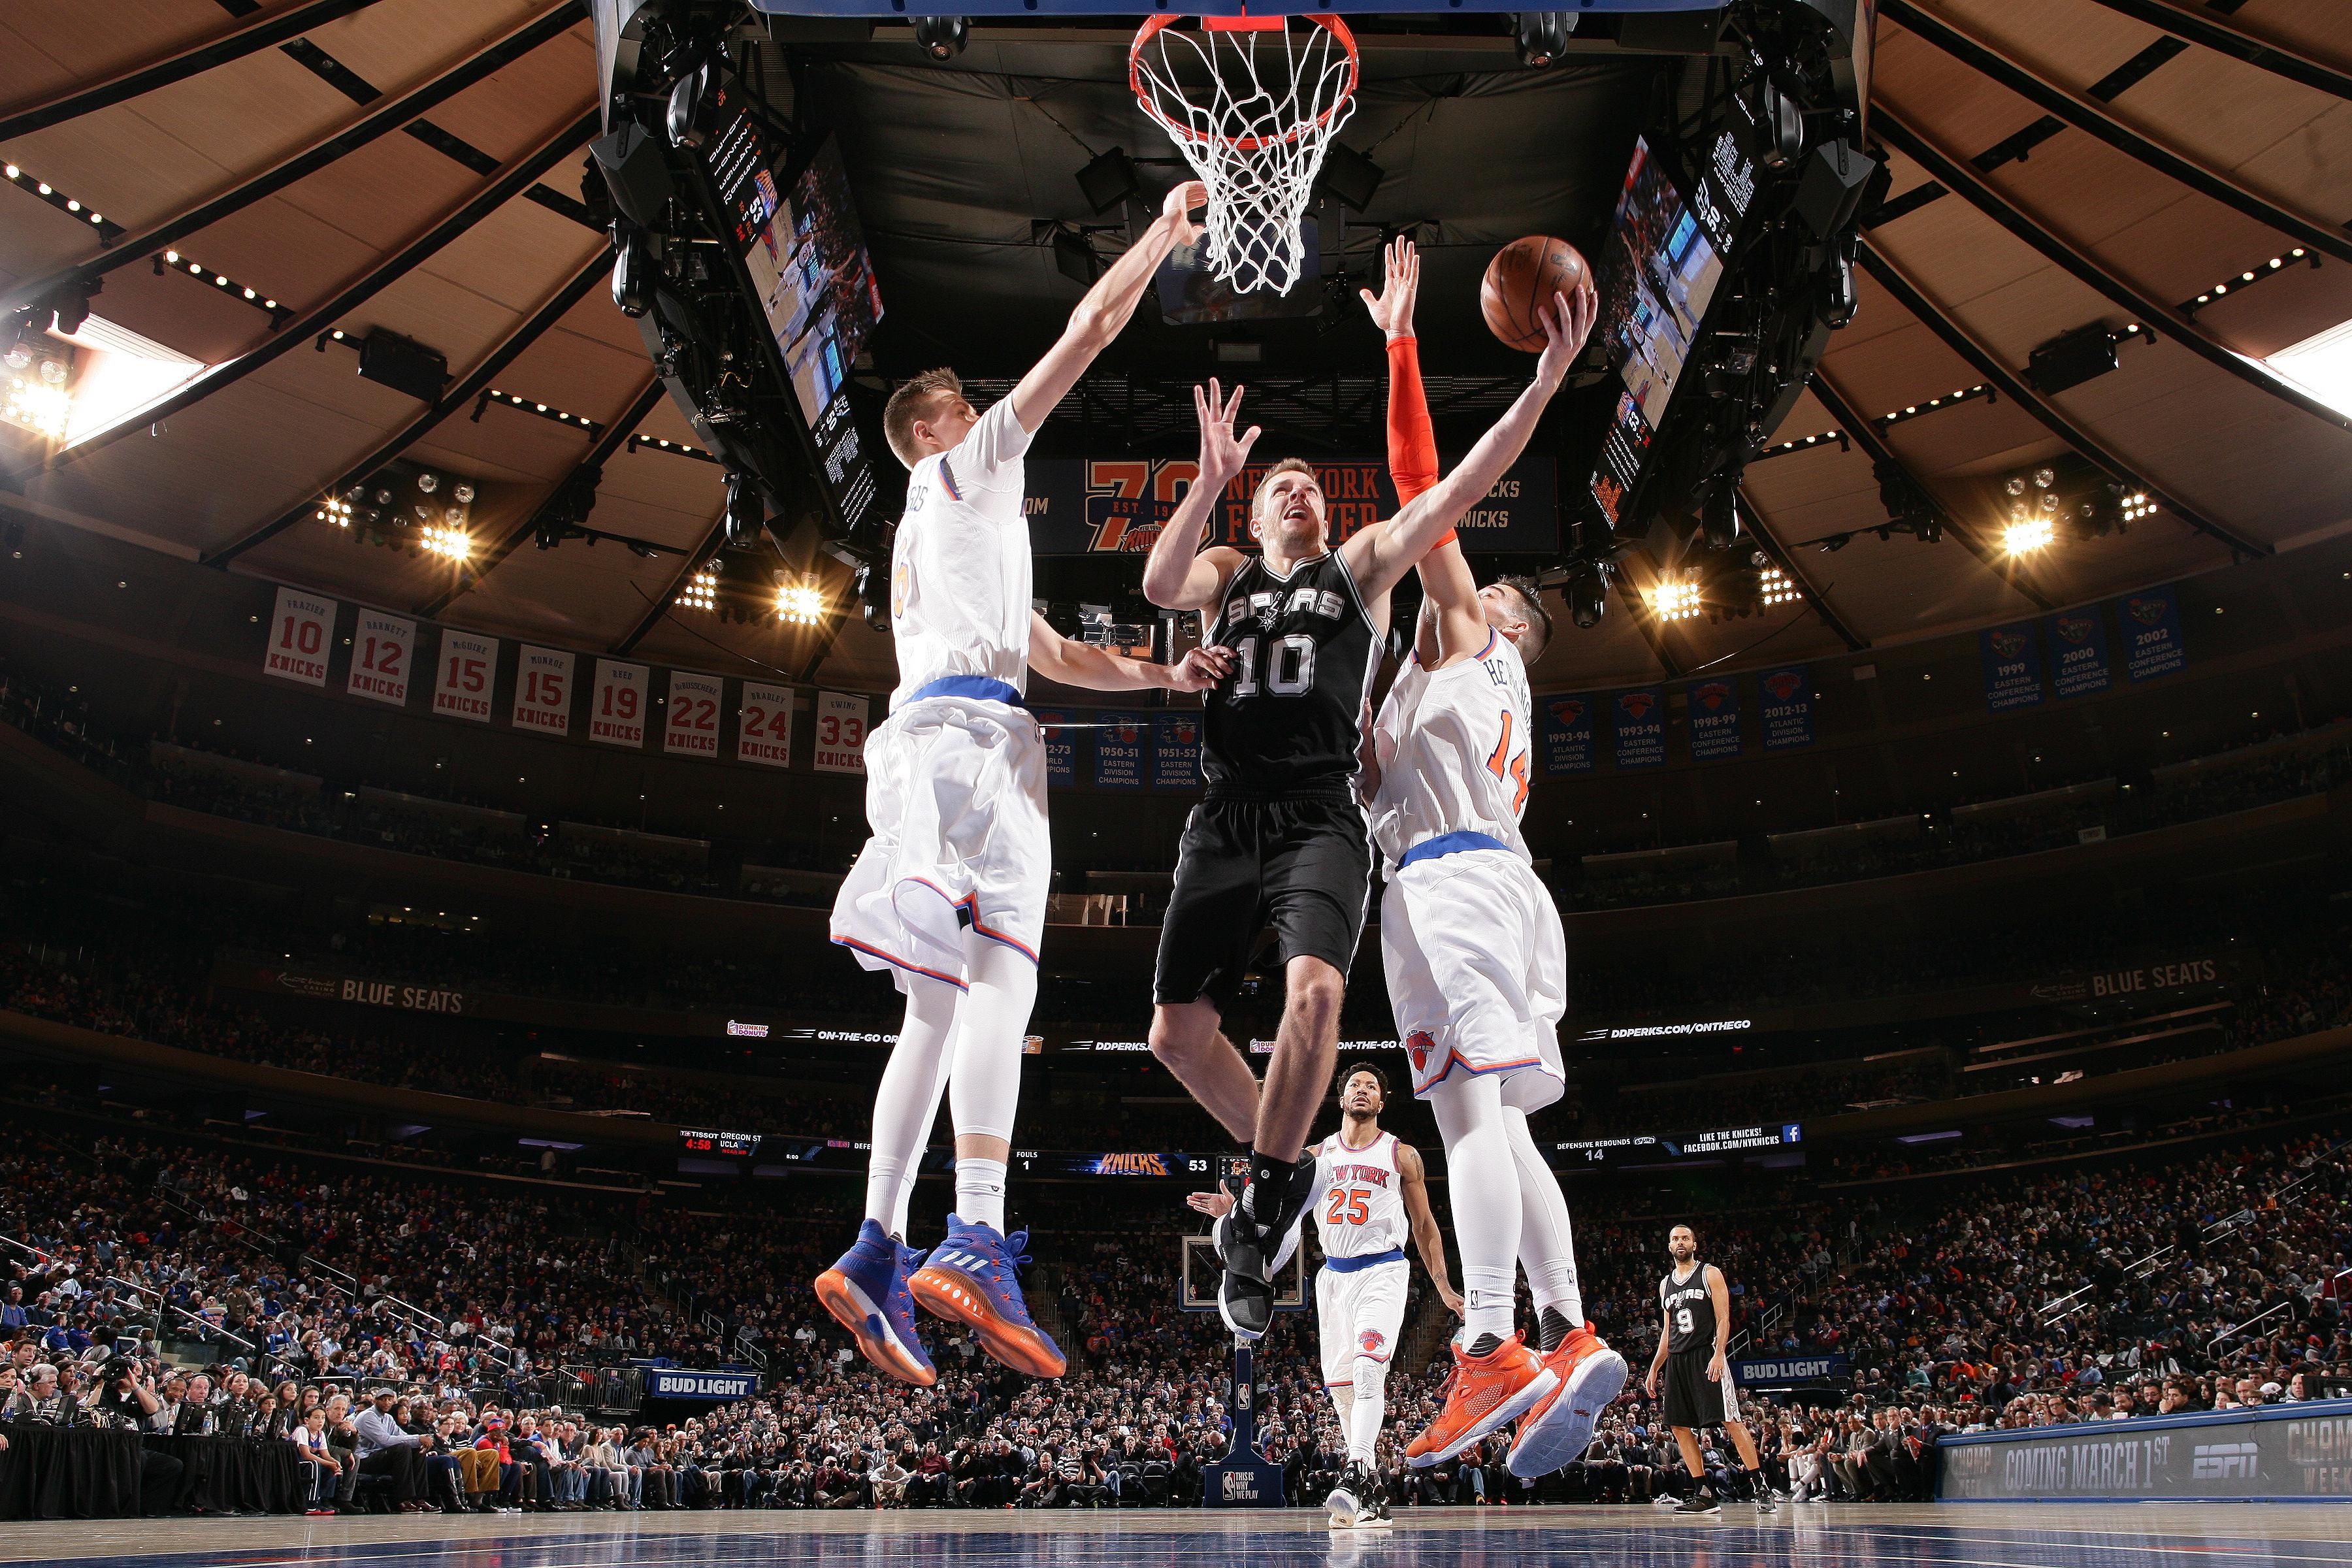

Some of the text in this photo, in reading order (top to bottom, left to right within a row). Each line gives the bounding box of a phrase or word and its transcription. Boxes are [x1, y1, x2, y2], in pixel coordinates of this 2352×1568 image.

[1716, 131, 1734, 171] LEONARD
[1723, 146, 1739, 180] PARKER
[1730, 169, 1739, 189] LEE
[1735, 157, 1754, 199] ALDRIDGE
[1741, 180, 1755, 208] GREEN
[750, 196, 765, 223] 53
[1707, 206, 1720, 232] 50
[1629, 411, 1640, 432] 53
[1315, 468, 1380, 498] ORK
[1113, 501, 1143, 515] EST.
[287, 599, 325, 616] FRAZIER
[1228, 588, 1345, 631] SPURS
[280, 616, 323, 655] 10
[366, 621, 408, 638] BARNETT
[2136, 628, 2168, 646] 2002
[362, 636, 403, 676] 12
[2135, 641, 2173, 658] EASTERN
[269, 653, 325, 679] KNICKS
[531, 655, 564, 669] MONROE
[1233, 634, 1317, 698] 10
[2129, 648, 2183, 670] CONFERENCE
[447, 656, 487, 693] 15
[612, 670, 632, 680] REED
[1997, 662, 2026, 677] 1999
[2061, 661, 2099, 676] EASTERN
[2133, 659, 2181, 679] CHAMPIONS
[351, 674, 404, 698] KNICKS
[1995, 676, 2031, 689] EASTERN
[2055, 668, 2109, 687] CONFERENCE
[525, 671, 563, 706] 15
[1987, 683, 2042, 699] CONFERENCE
[2059, 678, 2107, 695] CHAMPIONS
[437, 693, 488, 716] KNICKS
[600, 685, 638, 719] 19
[751, 691, 786, 705] BRADLEY
[830, 700, 857, 711] EWING
[1992, 693, 2039, 708] CHAMPIONS
[517, 707, 566, 728] KNICKS
[671, 696, 717, 730] 22
[1765, 703, 1808, 719] 2012-13
[745, 706, 786, 740] 24
[1693, 714, 1736, 729] 1998-99
[1769, 718, 1805, 729] ATLANTIC
[593, 721, 641, 742] KNICKS
[820, 715, 863, 747] 33
[1548, 730, 1590, 743] 1993-94
[1618, 724, 1661, 737] 1993-94
[1699, 728, 1732, 739] EASTERN
[1772, 727, 1803, 738] DIVISION
[667, 732, 715, 751] KNICKS
[1552, 744, 1586, 754] ATLANTIC
[1624, 738, 1656, 747] EASTERN
[1691, 735, 1741, 749] CONFERENCE
[1767, 734, 1810, 747] CHAMPIONS
[741, 741, 787, 761] KNICKS
[817, 750, 864, 768] KNICKS
[1100, 747, 1139, 758] 1950-51
[1158, 748, 1197, 758] 1951-52
[1554, 753, 1584, 762] DIVISION
[1617, 745, 1664, 757] CONFERENCE
[1695, 745, 1738, 757] CHAMPIONS
[1549, 761, 1591, 772] CHAMPIONS
[1620, 755, 1662, 766] CHAMPIONS
[1098, 776, 1139, 785] CHAMPIONS
[2093, 969, 2147, 996] BLUE
[2152, 958, 2216, 988] SEATS
[342, 979, 396, 1006] BLUE
[402, 987, 463, 1013] SEATS
[818, 1030, 881, 1043] ON-THE-GO
[1610, 1019, 1751, 1039] DDPERKS.COM/ONTHEGO
[1096, 1041, 1152, 1051] DDPERKS.
[1337, 1040, 1397, 1050] ON-THE-GO
[691, 1131, 719, 1140] TISSOT
[721, 1132, 751, 1142] OREGON
[1699, 1127, 1762, 1143] LIKE THE KNICKS!
[686, 1139, 711, 1151] 4:58
[1557, 1139, 1631, 1150] DEFENSIVE REBOUNDS
[1684, 1135, 1780, 1153] FACEBOOK.COM/NYKNICKS
[1585, 1149, 1604, 1161] 14
[1022, 1160, 1030, 1170] 1
[1096, 1153, 1168, 1175] KNICKS
[1188, 1160, 1207, 1171] 53
[1350, 1165, 1389, 1189] YORK
[1327, 1188, 1371, 1226] 25
[1676, 1308, 1695, 1333] 9
[1743, 1360, 1829, 1380] BUD LIGHT
[659, 1377, 747, 1395] BUD LIGHT
[2288, 1419, 2352, 1462] CHAM
[1951, 1446, 1991, 1475] CHAMP
[2006, 1436, 2170, 1492] COMING MARCH 1ST
[2193, 1442, 2258, 1479] ESPN
[1235, 1472, 1254, 1481] THIS IS
[1235, 1481, 1248, 1490] WHY
[1236, 1490, 1258, 1499] WE PLAY
